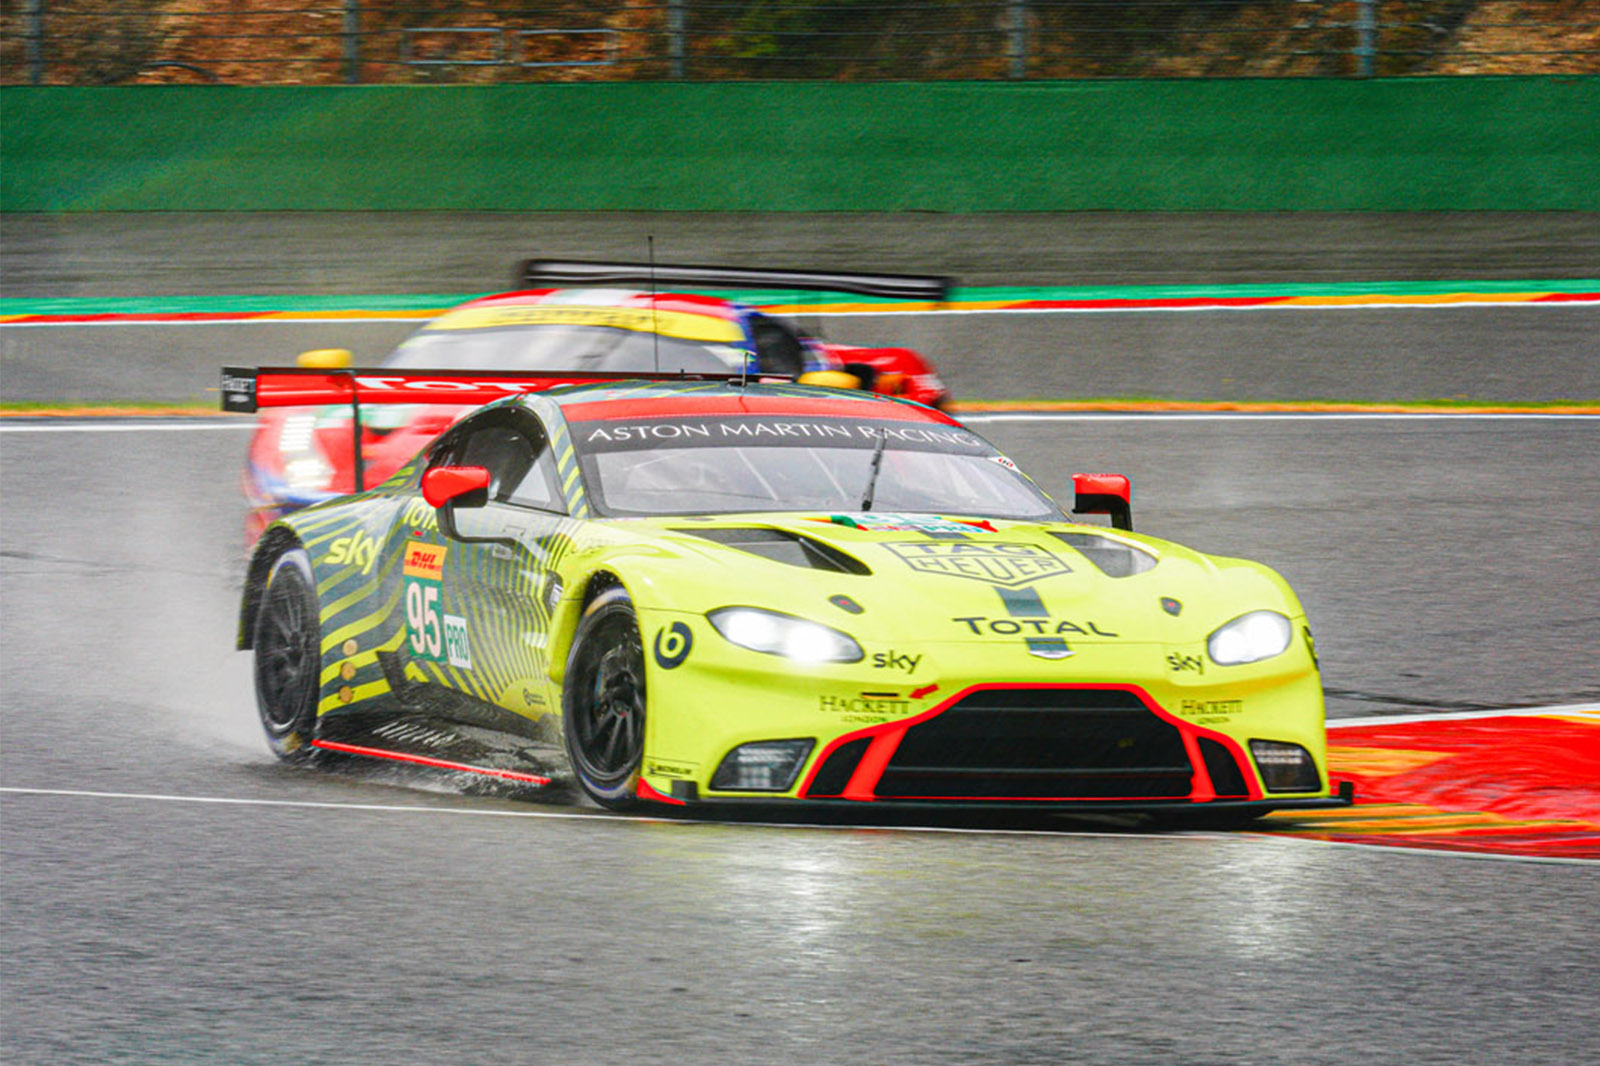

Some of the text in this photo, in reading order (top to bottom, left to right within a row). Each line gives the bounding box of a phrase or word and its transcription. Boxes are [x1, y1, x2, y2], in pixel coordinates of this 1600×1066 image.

[588, 422, 981, 447] ASTON MARTIN RACING
[324, 530, 384, 576] sky
[410, 551, 437, 570] DHL
[905, 543, 1036, 556] TAG
[916, 556, 1060, 581] HEUER
[406, 582, 441, 658] 95
[952, 617, 1119, 638] TOTAL
[446, 623, 469, 662] PRO
[872, 650, 923, 675] sky
[1167, 652, 1204, 676] sky
[819, 696, 911, 715] HACKETT
